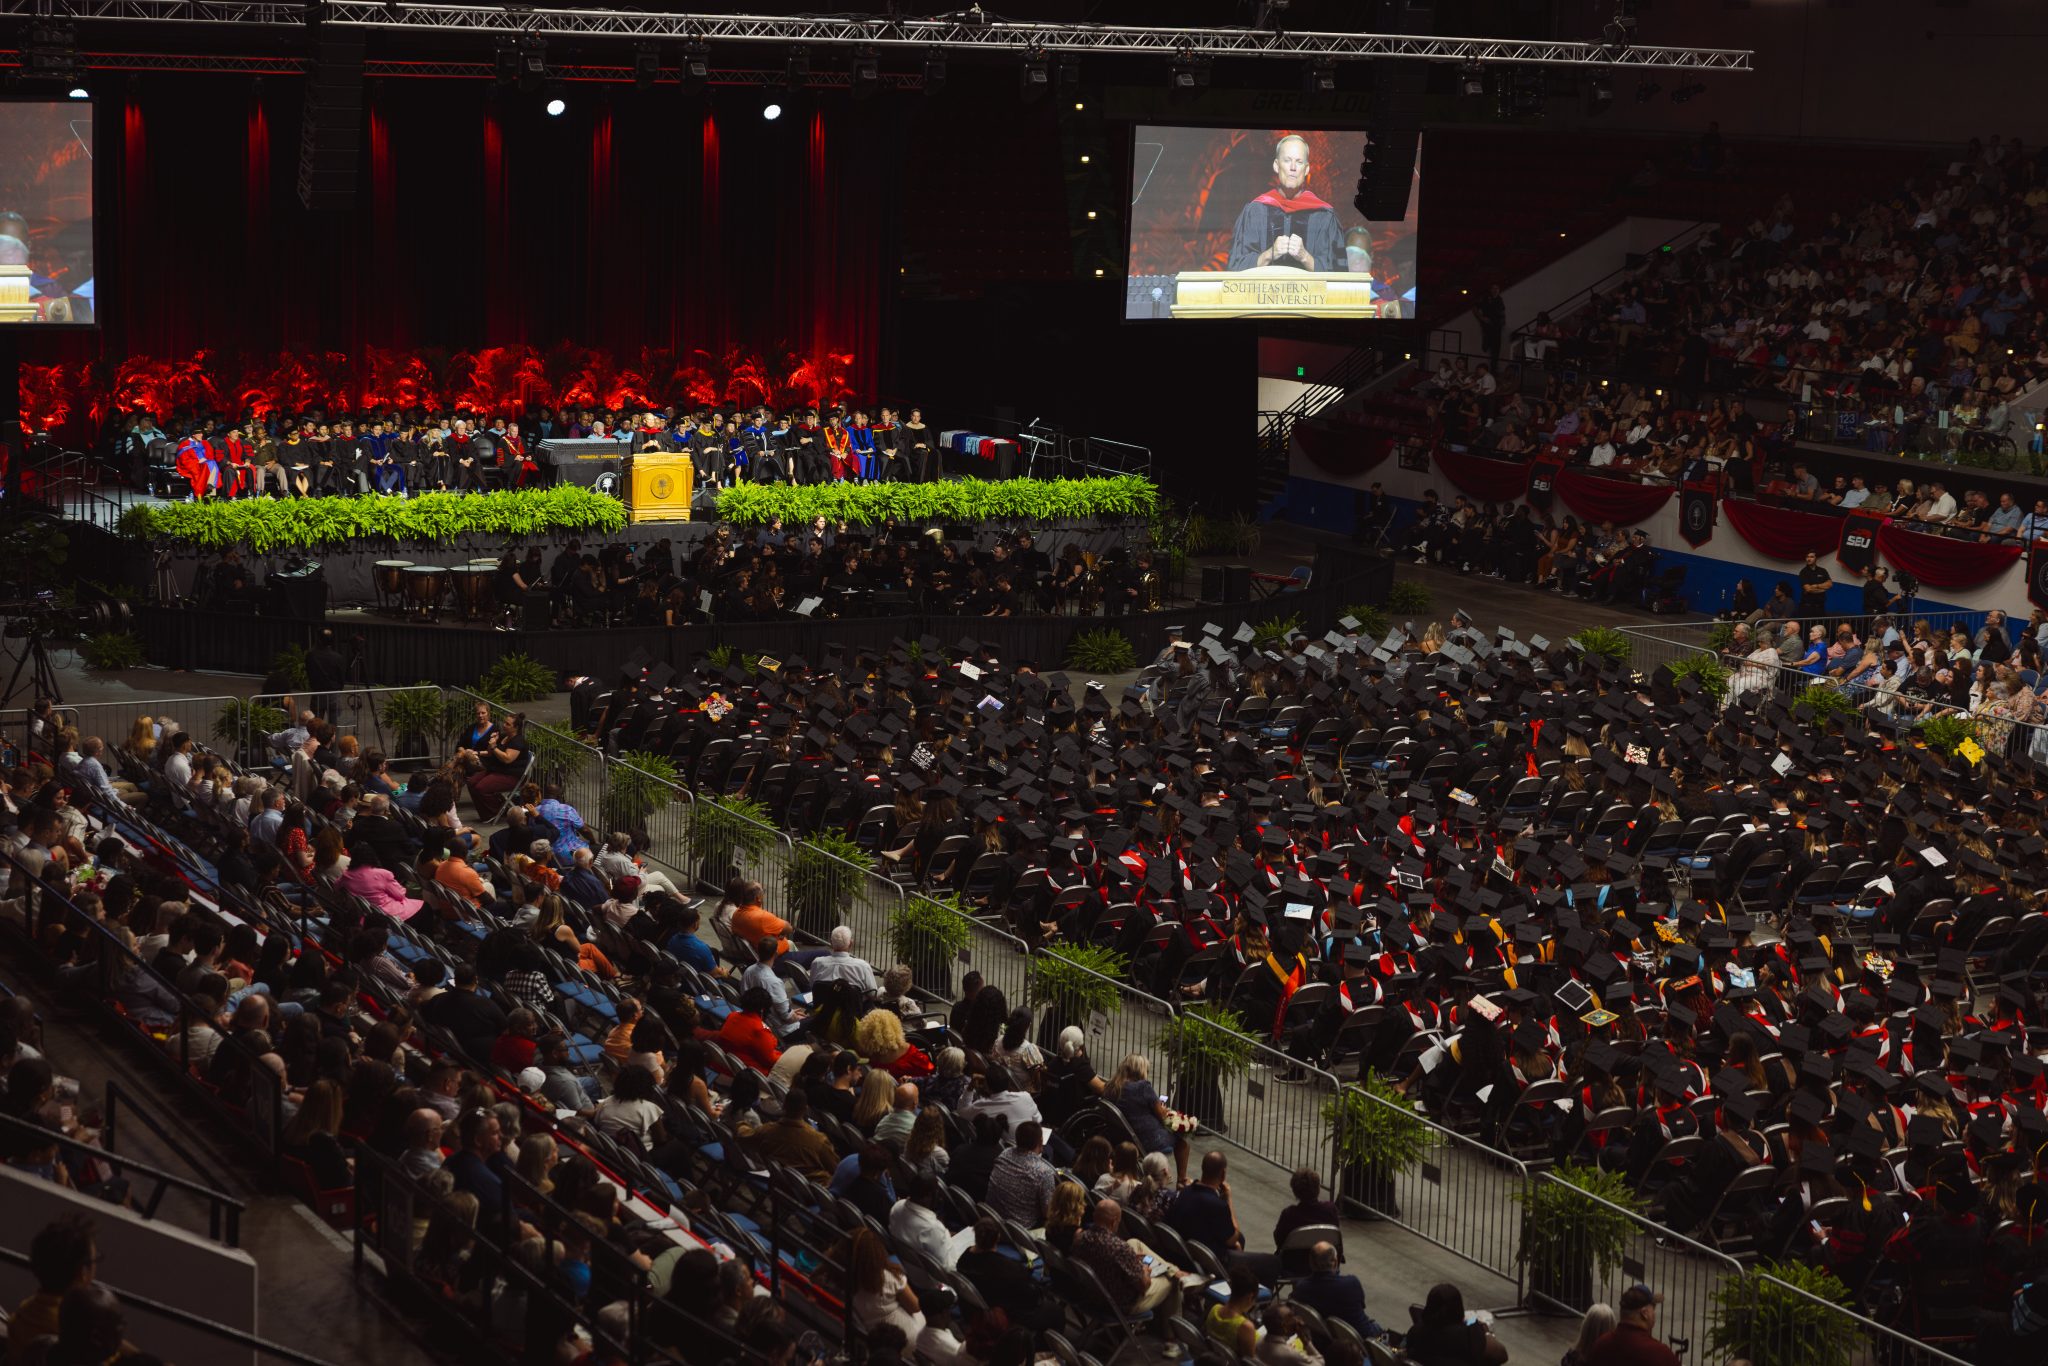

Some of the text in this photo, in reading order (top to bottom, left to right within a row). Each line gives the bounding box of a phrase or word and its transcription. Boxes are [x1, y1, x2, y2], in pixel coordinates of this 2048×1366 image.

[1223, 281, 1308, 293] SOUTHEASTERN
[1258, 294, 1325, 304] UNIVERSITY
[1839, 414, 1856, 424] 123
[1533, 479, 1551, 491] SEU
[1846, 535, 1872, 549] SEU
